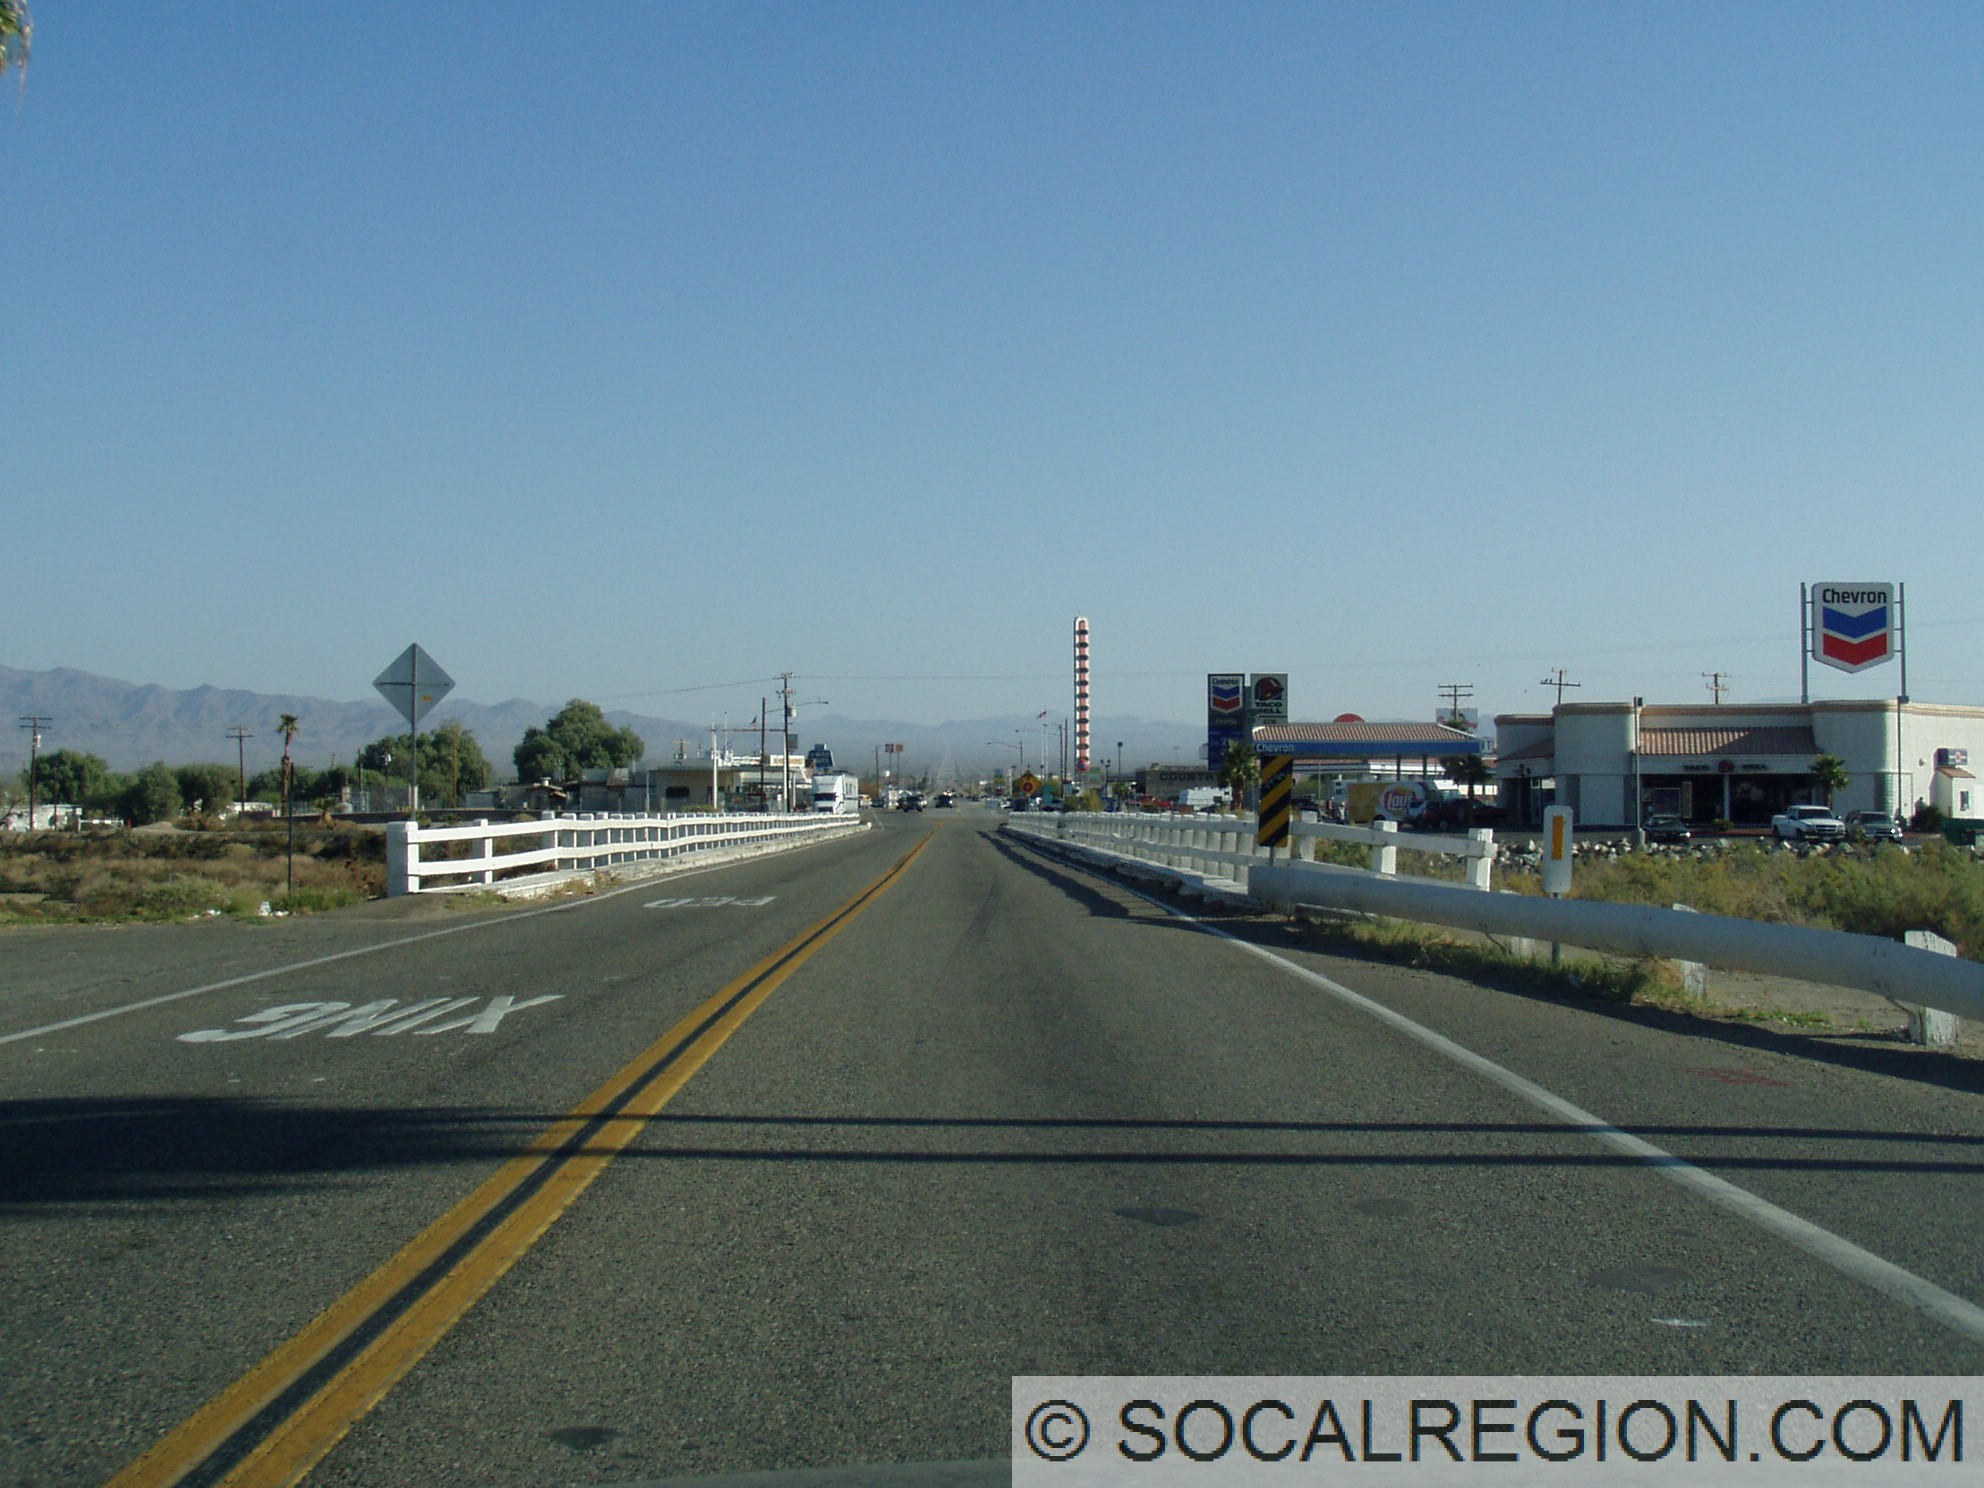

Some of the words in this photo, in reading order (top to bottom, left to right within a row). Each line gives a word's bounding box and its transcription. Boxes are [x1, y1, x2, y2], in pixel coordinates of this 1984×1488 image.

[1822, 588, 1887, 604] Chevron
[1256, 743, 1295, 752] Chevron
[643, 896, 777, 908] PED
[175, 994, 567, 1042] XING
